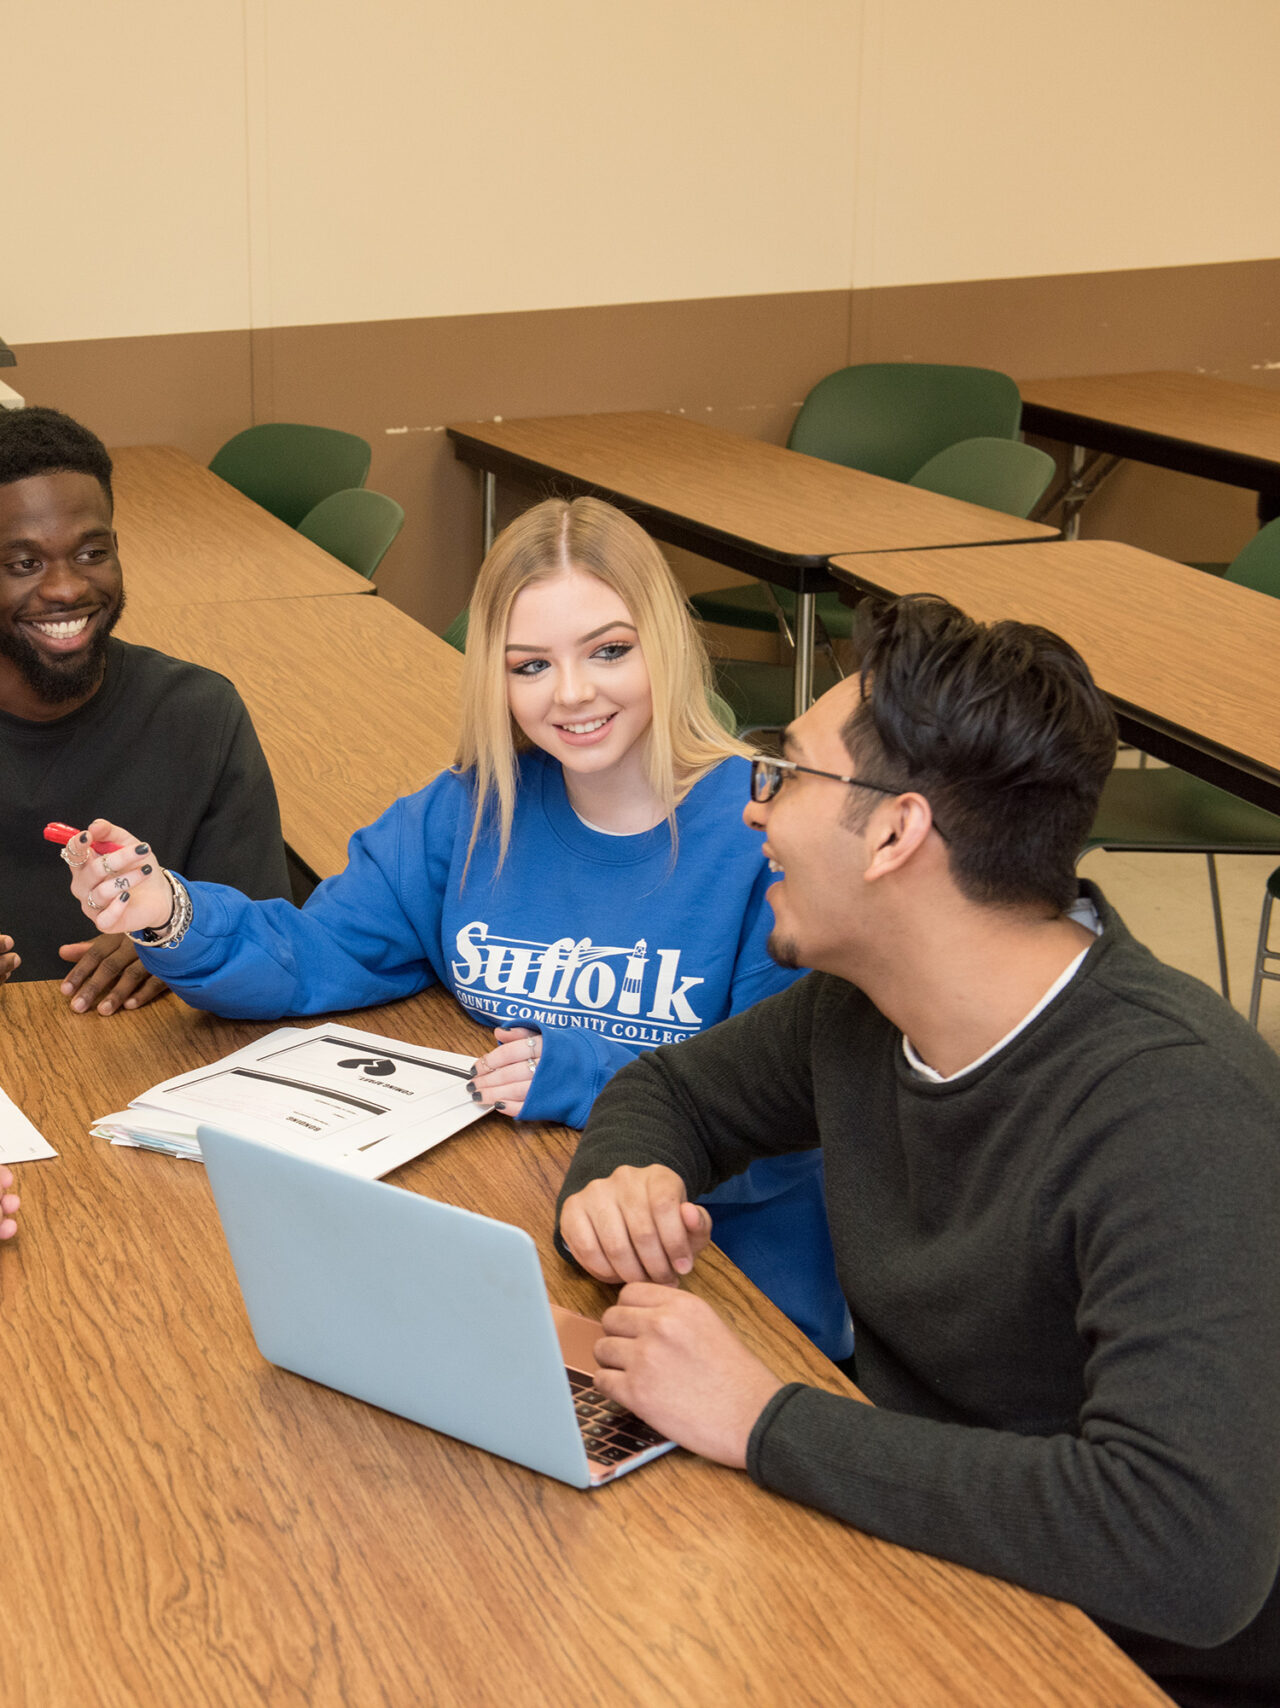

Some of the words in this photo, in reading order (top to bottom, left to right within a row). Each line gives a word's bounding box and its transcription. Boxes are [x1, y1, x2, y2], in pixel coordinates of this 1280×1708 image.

[451, 921, 705, 1023] Suffolk
[456, 989, 501, 1013] COUNTY
[506, 1004, 607, 1032] COMMUNITY
[611, 1023, 697, 1044] COLLEG
[286, 1116, 322, 1132] BONDING
